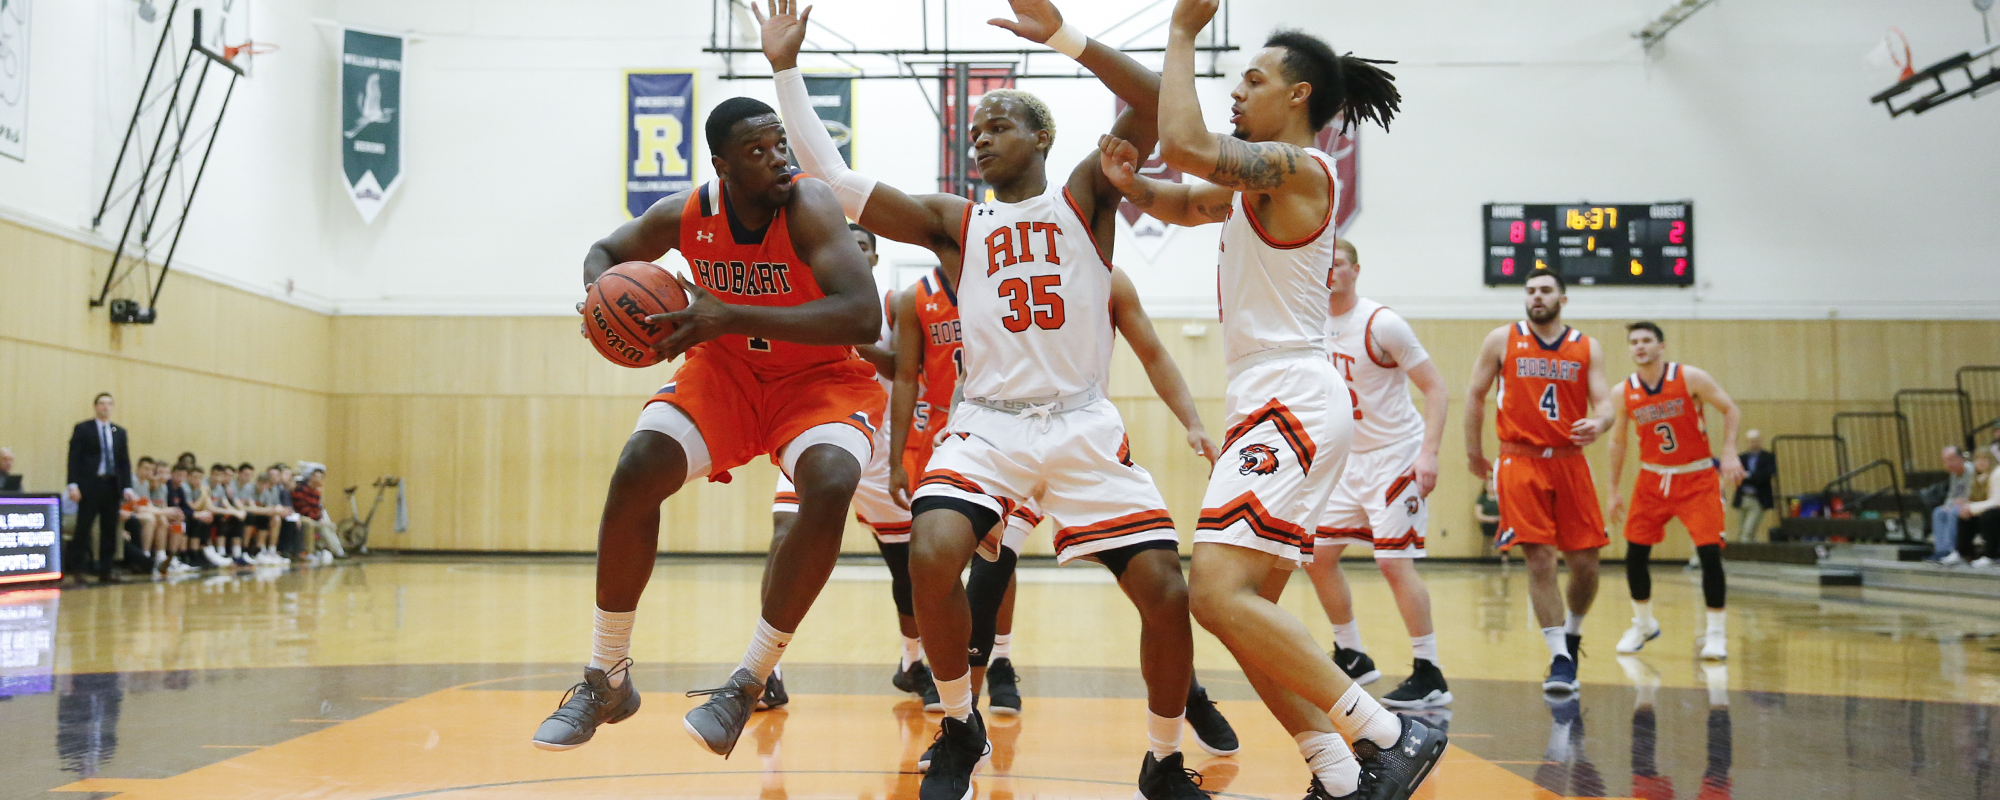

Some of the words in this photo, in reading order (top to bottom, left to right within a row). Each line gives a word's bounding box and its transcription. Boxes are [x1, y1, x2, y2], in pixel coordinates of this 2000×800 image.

[634, 114, 688, 176] R
[1492, 205, 1525, 219] HOME
[1566, 208, 1618, 230] 16:37
[1649, 204, 1685, 219] GUEST
[1668, 220, 1686, 244] 2
[985, 221, 1063, 278] RIT
[693, 259, 792, 296] HOBART
[615, 292, 662, 337] NCAA
[998, 274, 1065, 333] 35
[592, 303, 645, 363] Wilson
[928, 319, 962, 345] HOB
[1516, 357, 1581, 382] HOBART
[914, 401, 930, 432] 5
[1539, 383, 1559, 421] 4
[1632, 398, 1685, 425] HOBART
[1654, 422, 1678, 454] 3
